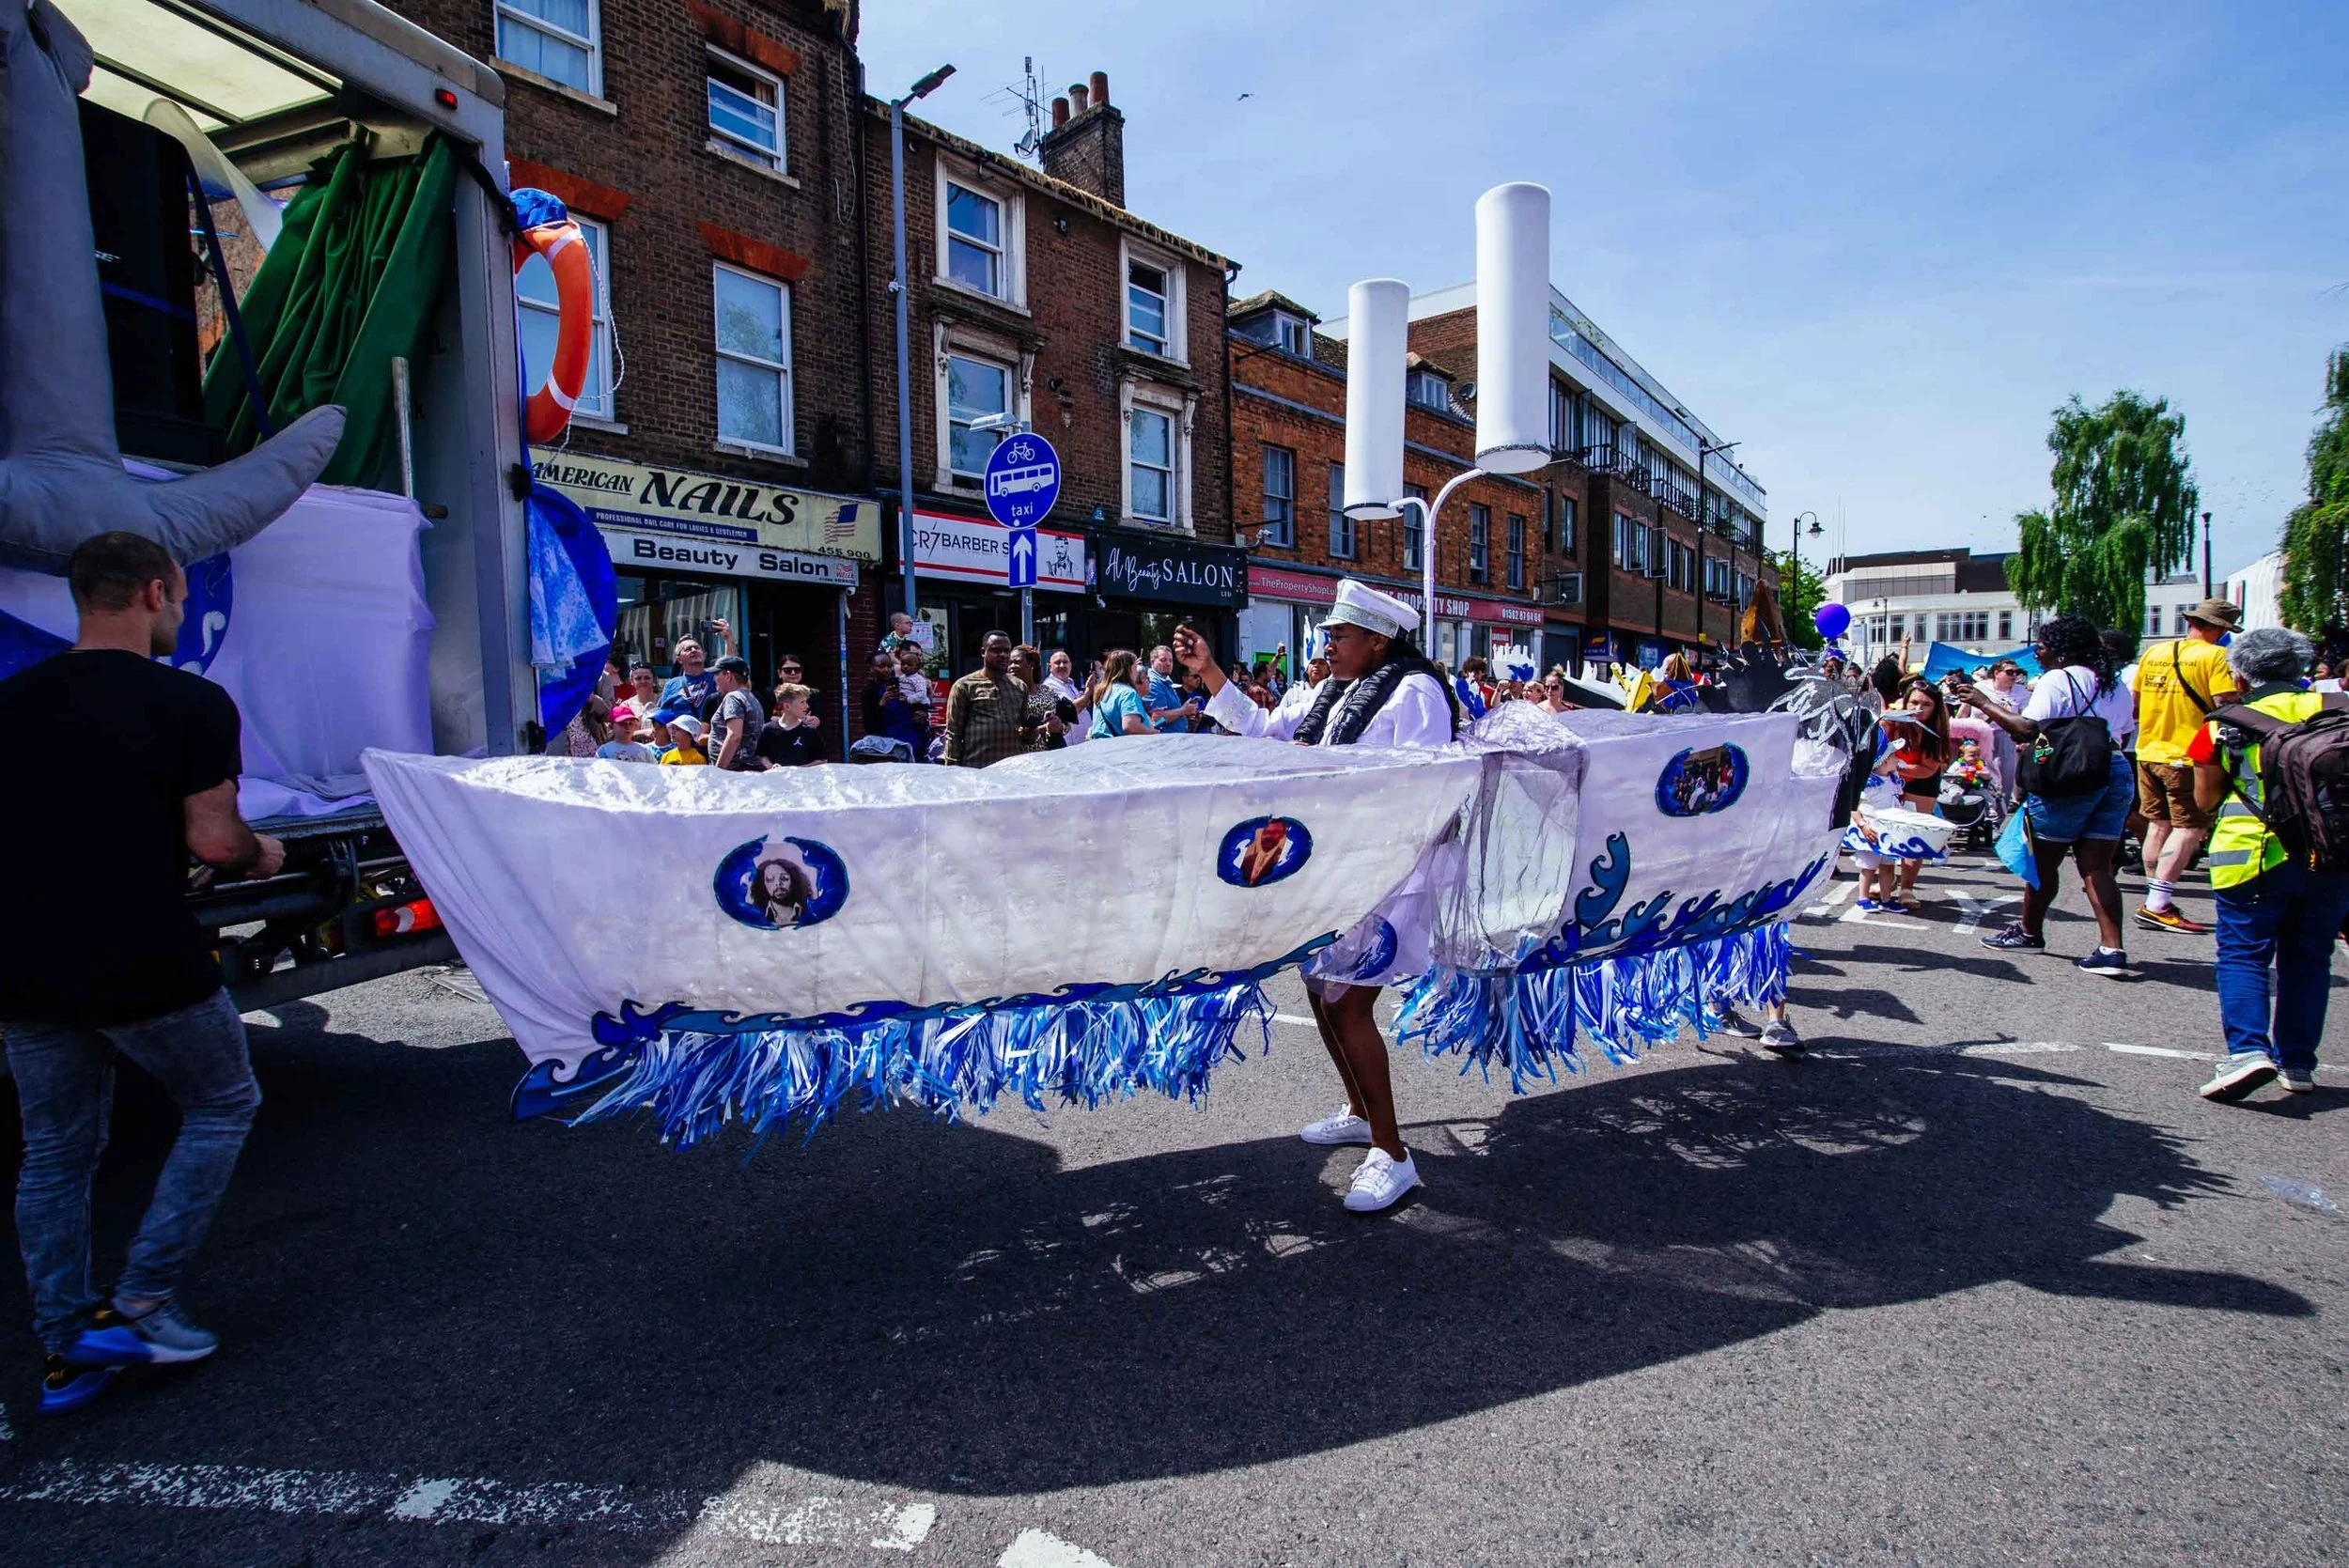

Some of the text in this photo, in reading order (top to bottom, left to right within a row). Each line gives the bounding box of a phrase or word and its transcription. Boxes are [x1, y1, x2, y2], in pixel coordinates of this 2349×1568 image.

[532, 461, 800, 525] AMERICAN NAILS
[1011, 501, 1034, 517] taxi
[596, 511, 643, 525] PROFESSIONAL
[677, 521, 688, 531] FOR
[689, 523, 708, 534] LADIES
[847, 549, 871, 559] 900
[941, 533, 999, 554] BARBER
[633, 538, 829, 577] Beauty Salon
[1125, 555, 1162, 592] Beauty
[1162, 558, 1234, 588] SALON
[1446, 598, 1470, 616] SHOP
